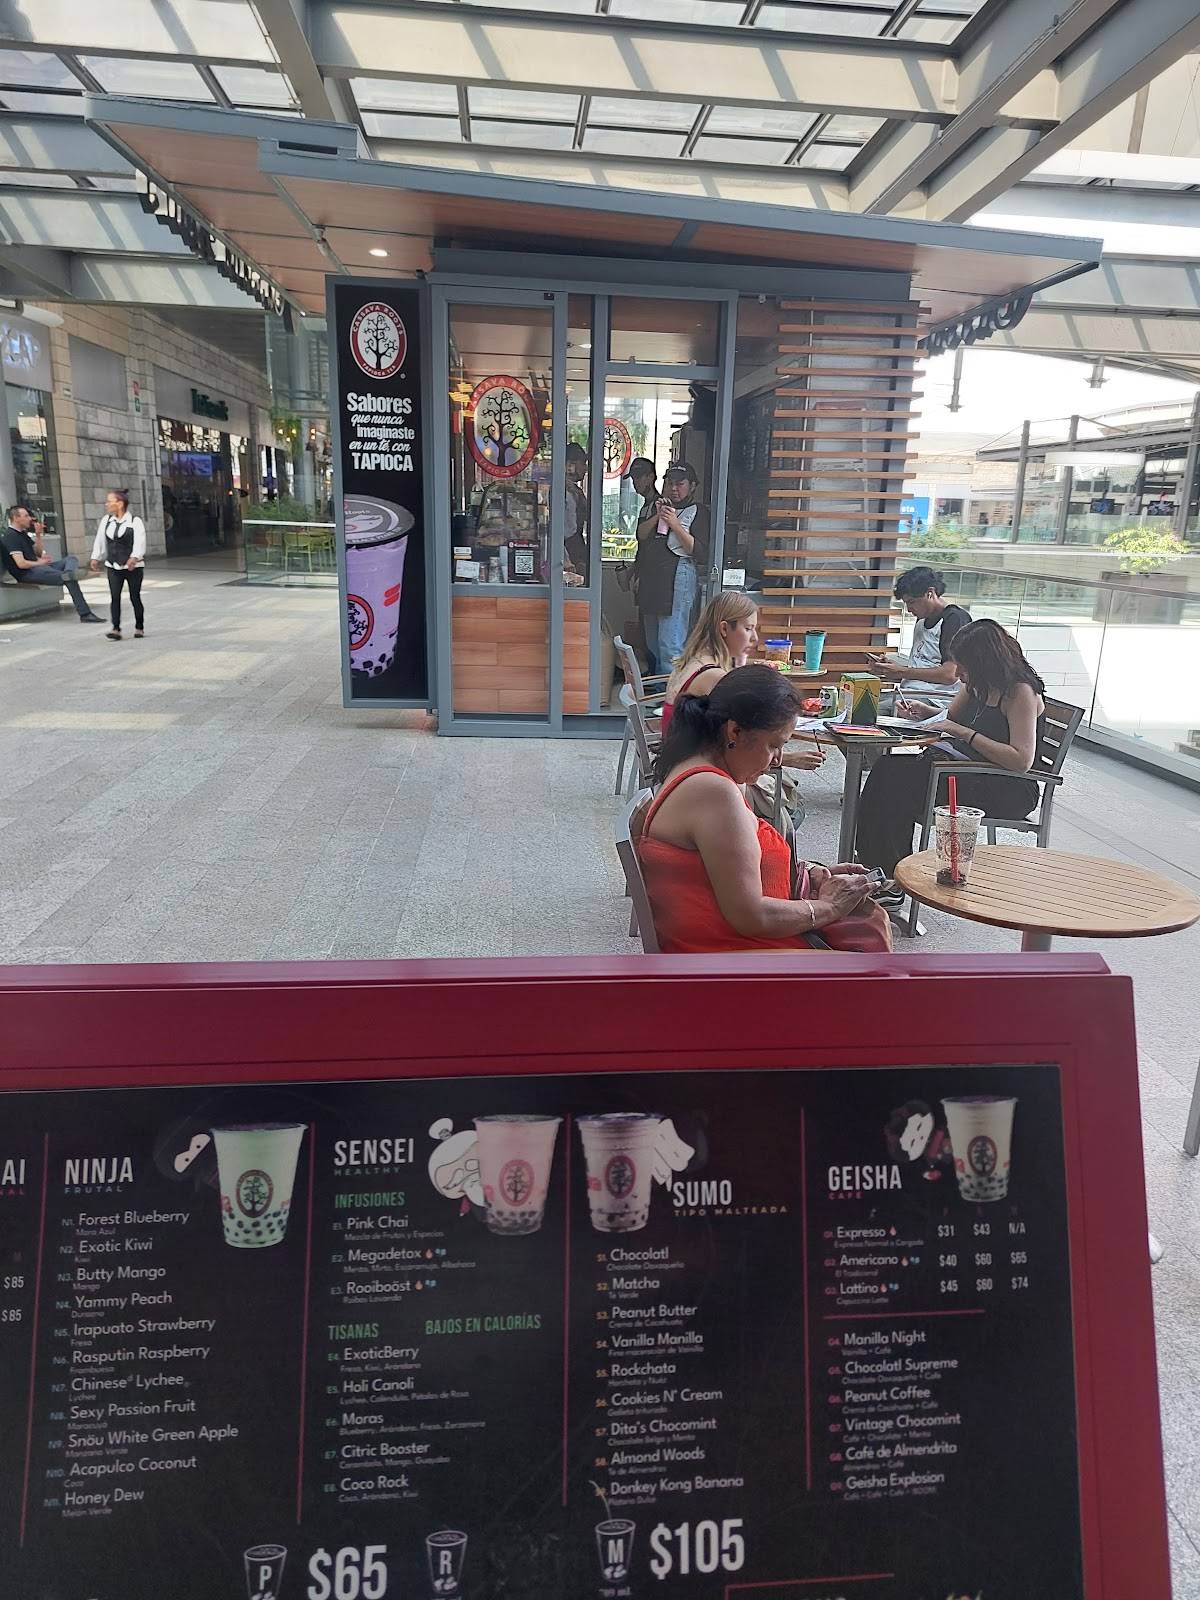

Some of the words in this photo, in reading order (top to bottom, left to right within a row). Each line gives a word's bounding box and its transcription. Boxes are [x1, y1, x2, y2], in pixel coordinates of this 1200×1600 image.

[346, 392, 412, 415] Sabores
[351, 413, 371, 427] que
[370, 414, 404, 426] nunca
[356, 424, 415, 441] imaginaste
[349, 438, 363, 450] en
[363, 439, 378, 451] un
[391, 442, 411, 452] con
[352, 452, 414, 472] TAPIOCA
[334, 1138, 414, 1166] SENSEI
[65, 1157, 133, 1185] NINJA
[334, 1167, 400, 1176] HEALTHY
[828, 1165, 902, 1191] GEISHA
[65, 1185, 124, 1194] FRUTAL
[673, 1180, 732, 1207] SUMO
[335, 1192, 405, 1209] INFUSIONES
[78, 1213, 120, 1226] Forest
[124, 1210, 190, 1225] Blueberry
[715, 1205, 788, 1215] MALTEADA
[346, 1216, 374, 1229] Pink
[378, 1215, 409, 1228] Chai
[837, 1226, 886, 1241] Expresso
[938, 1225, 954, 1237] $31
[973, 1223, 991, 1236] $43
[1008, 1222, 1026, 1234] N/A
[80, 1238, 121, 1254] Exotic
[125, 1237, 153, 1251] Kiwi
[347, 1247, 422, 1265] Megadetox
[610, 1247, 669, 1262] Chocolatl
[840, 1254, 899, 1267] Americano
[939, 1254, 957, 1267] $40
[4, 1276, 24, 1289] $85
[77, 1267, 114, 1282] Butty
[118, 1266, 166, 1281] Mango
[612, 1276, 660, 1290] Matcha
[840, 1281, 879, 1294] Lattino
[940, 1280, 958, 1293] $45
[1011, 1276, 1029, 1290] $74
[75, 1295, 127, 1310] Yammy
[131, 1290, 173, 1305] Peach
[1, 1309, 22, 1322] $85
[612, 1306, 656, 1319] Peanut
[658, 1304, 698, 1317] Butter
[73, 1322, 134, 1338] Irapuato
[138, 1316, 215, 1333] Strawberry
[328, 1323, 379, 1340] TISANAS
[425, 1319, 462, 1334] BAJOS
[465, 1317, 481, 1333] EN
[484, 1314, 541, 1331] CALORÍAS
[611, 1333, 655, 1348] Vanilla
[657, 1331, 704, 1345] Manilla
[843, 1331, 889, 1346] Manilla
[892, 1330, 926, 1345] Night
[72, 1348, 134, 1365] Rasputin
[138, 1345, 210, 1362] Raspberry
[344, 1345, 420, 1361] ExoticBerry
[611, 1362, 676, 1377] Rockchata
[845, 1358, 902, 1374] Chocolatl
[905, 1358, 959, 1373] Supreme
[71, 1376, 128, 1391] Chinese
[136, 1373, 184, 1391] Lychee
[343, 1379, 369, 1393] Holi
[371, 1376, 415, 1391] Canoli
[611, 1391, 660, 1406] Cookies
[680, 1387, 723, 1402] Cream
[845, 1389, 887, 1403] Peanut
[890, 1386, 931, 1400] Coffee
[70, 1405, 104, 1421] Sexy
[108, 1402, 160, 1417] Passion
[164, 1399, 196, 1413] Fruit
[342, 1411, 384, 1426] Moras
[649, 1417, 717, 1433] Chocomint
[845, 1418, 894, 1433] Vintage
[896, 1412, 961, 1428] Chocomint
[108, 1430, 149, 1445] White
[152, 1428, 195, 1442] Green
[198, 1424, 239, 1440] Apple
[340, 1444, 377, 1458] Citric
[380, 1442, 431, 1456] Booster
[611, 1450, 660, 1466] Almond
[663, 1446, 706, 1461] Woods
[845, 1445, 875, 1460] Café
[876, 1444, 891, 1459] de
[893, 1440, 958, 1457] Almendrita
[70, 1459, 135, 1478] Acapulco
[138, 1456, 197, 1471] Coconut
[341, 1477, 375, 1491] Coco
[377, 1474, 409, 1488] Rock
[610, 1482, 657, 1496] Donkey
[659, 1478, 692, 1493] Kong
[694, 1475, 744, 1490] Banana
[846, 1474, 888, 1489] Geisha
[889, 1470, 944, 1487] Explosion
[64, 1492, 110, 1507] Honey
[114, 1488, 145, 1502] Dew
[607, 1538, 623, 1564] M
[650, 1518, 745, 1580] $105
[440, 1550, 453, 1576] R
[259, 1565, 272, 1591] P
[307, 1544, 388, 1600] $65
